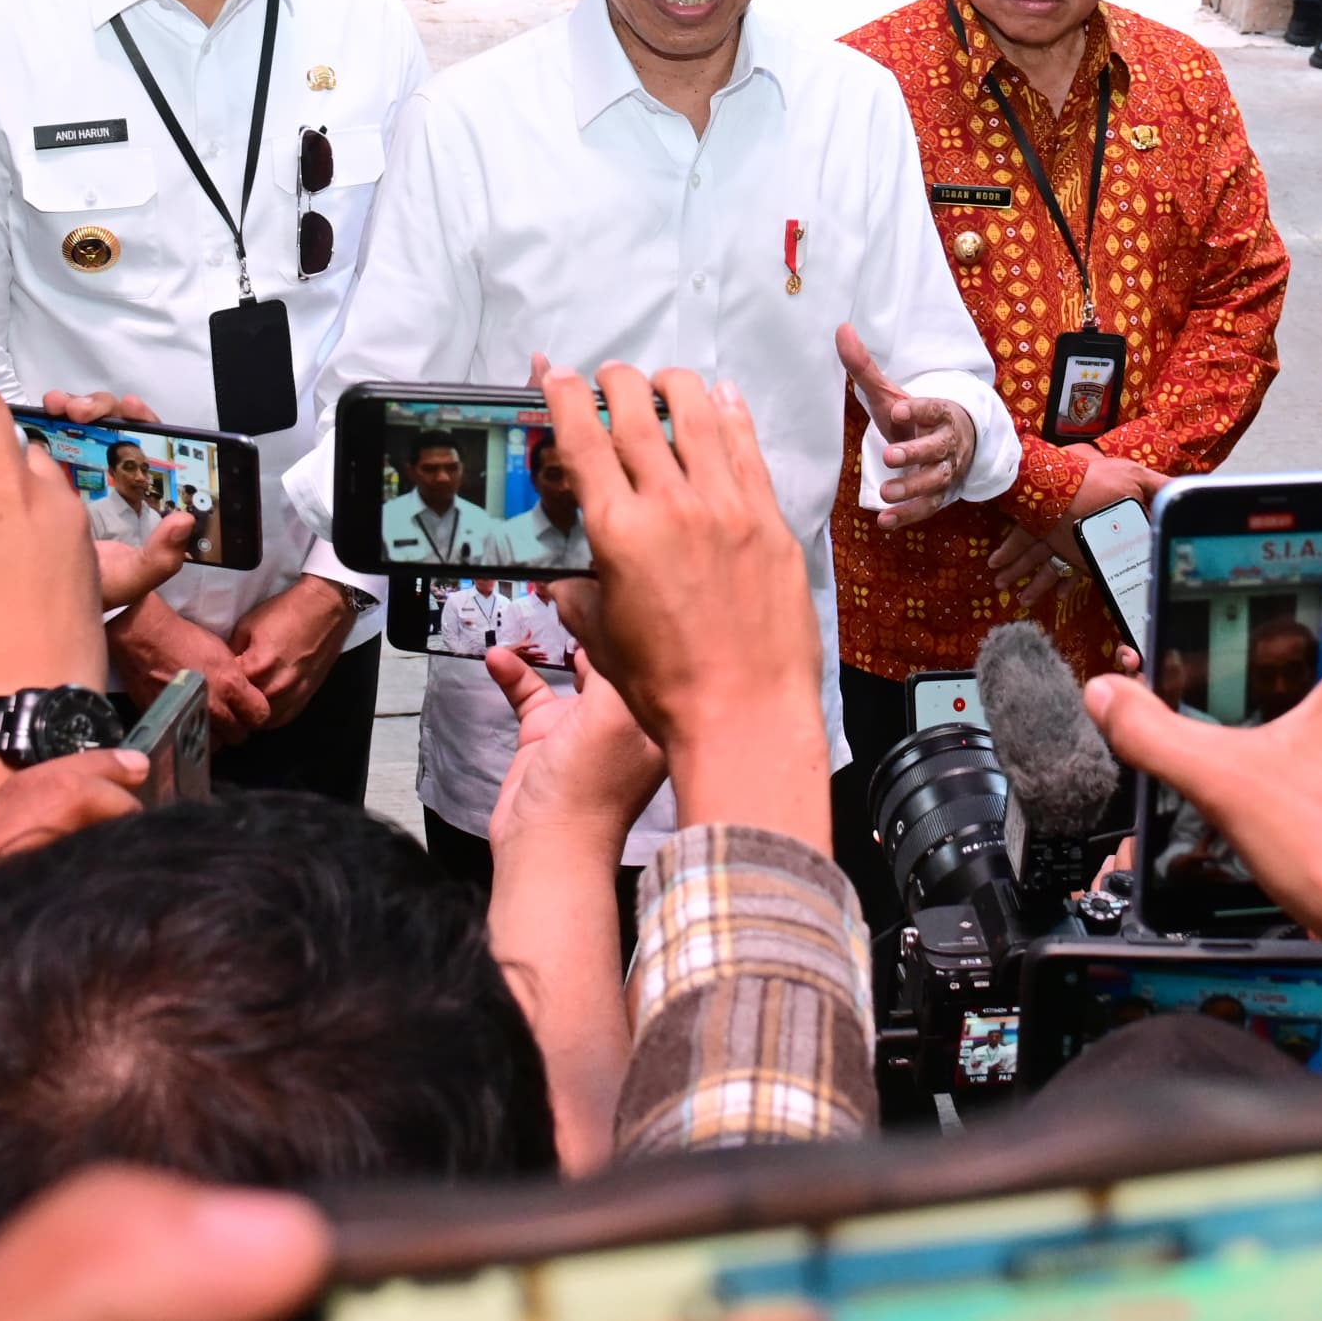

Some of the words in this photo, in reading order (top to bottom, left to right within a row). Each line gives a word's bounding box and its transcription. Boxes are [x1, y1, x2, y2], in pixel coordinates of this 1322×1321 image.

[55, 129, 78, 142] ANDI
[78, 126, 111, 141] HARUN
[941, 189, 970, 200] ISRAN
[975, 191, 1001, 201] NOOR
[896, 820, 905, 835] G
